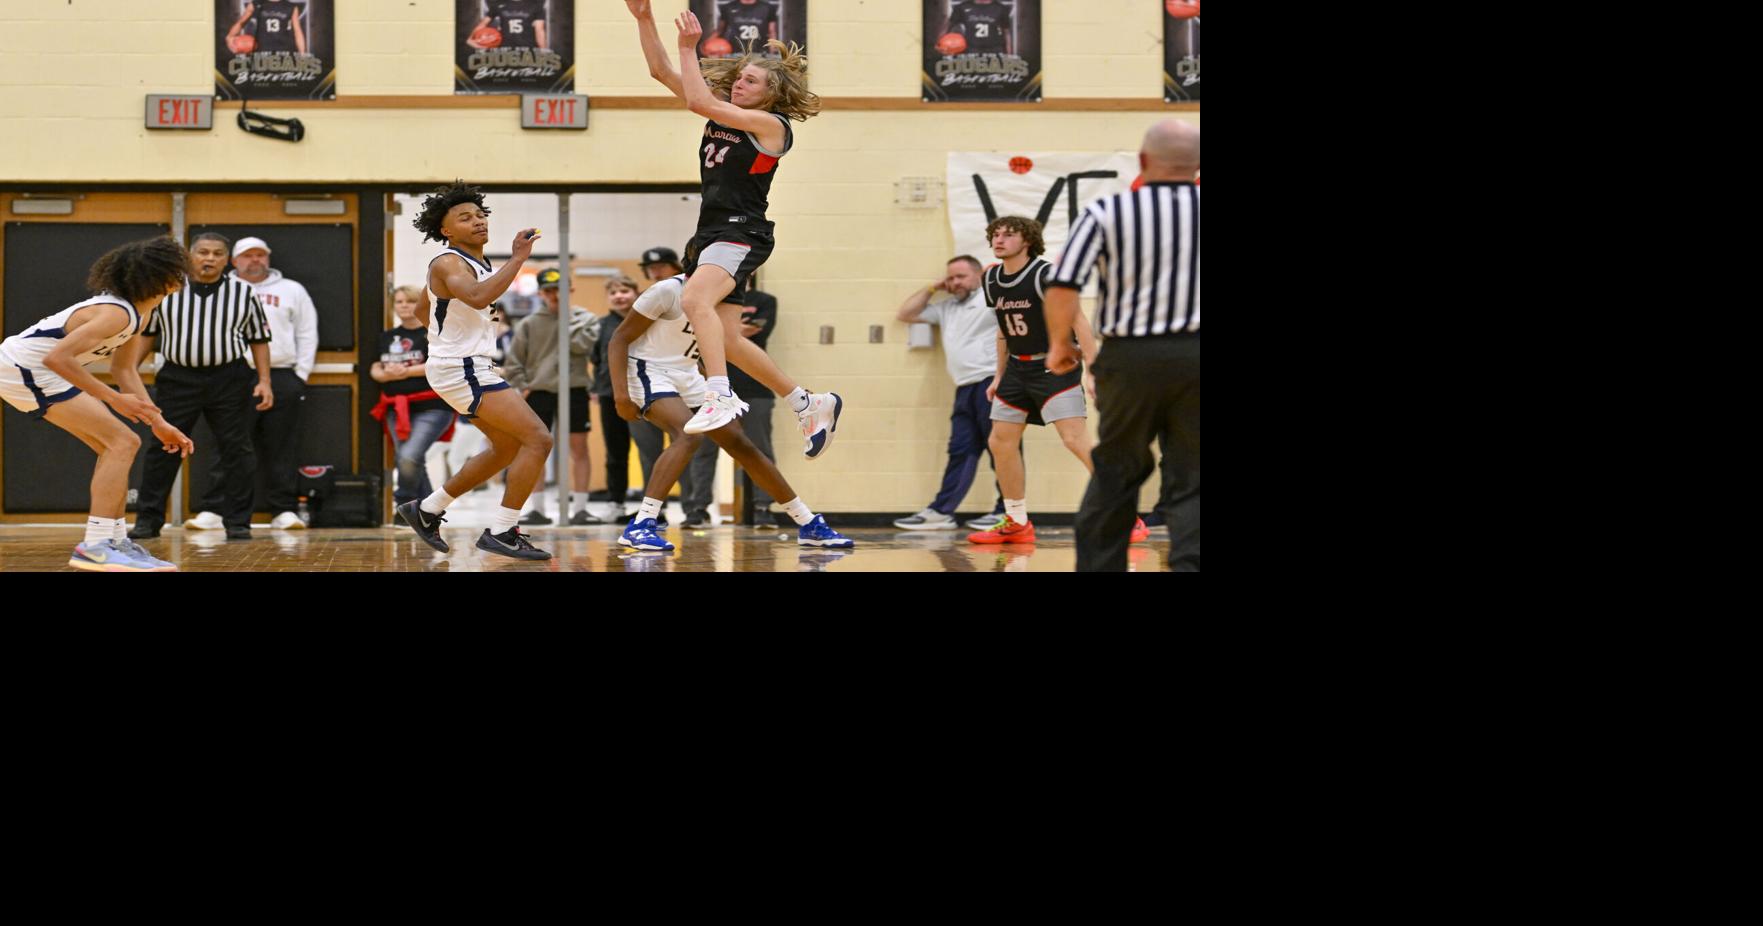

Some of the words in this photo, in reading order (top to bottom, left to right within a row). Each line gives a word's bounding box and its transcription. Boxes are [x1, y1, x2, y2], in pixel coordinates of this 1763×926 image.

[266, 18, 281, 32] 13
[508, 19, 524, 34] 15
[975, 23, 990, 38] 21
[228, 53, 323, 75] COUGARS
[468, 48, 562, 71] COUGARS
[935, 55, 1029, 77] COUGARS
[159, 99, 202, 125] EXIT
[534, 98, 577, 125] EXIT
[704, 125, 743, 144] Marcus
[703, 142, 730, 169] 24
[995, 296, 1032, 310] Marcus
[1004, 313, 1029, 337] 15
